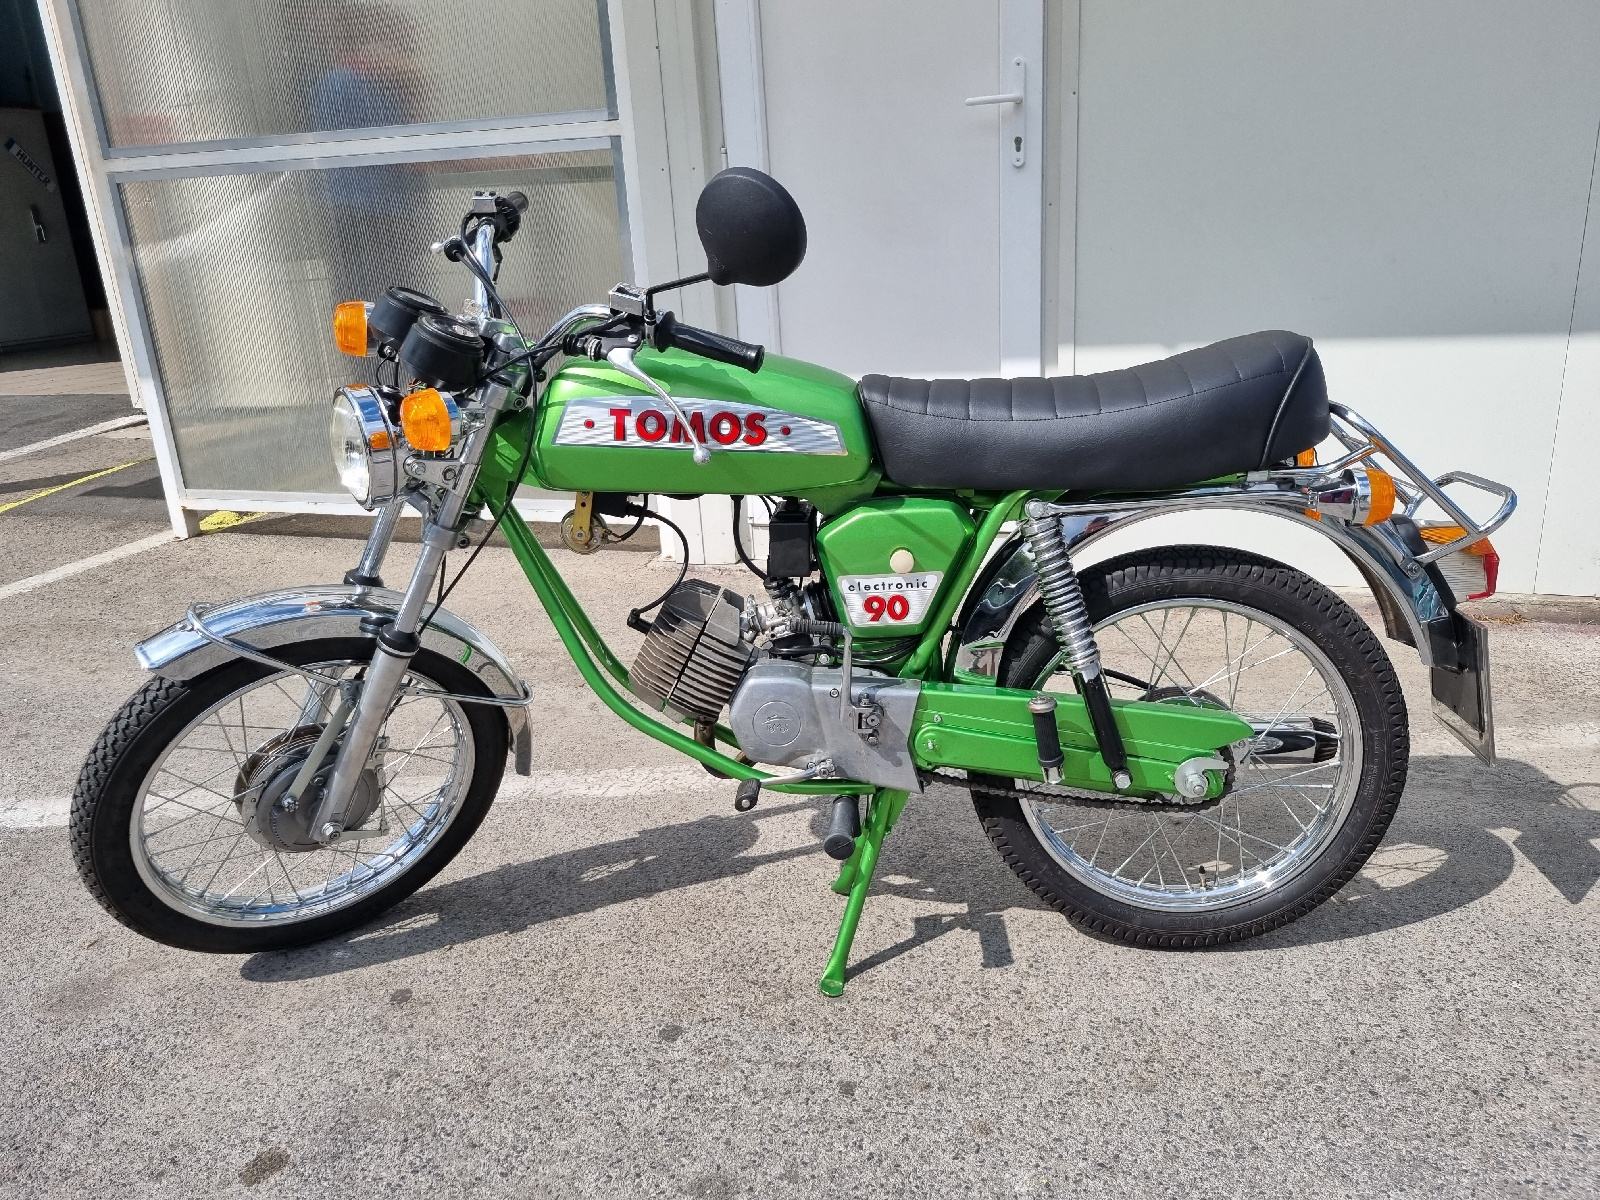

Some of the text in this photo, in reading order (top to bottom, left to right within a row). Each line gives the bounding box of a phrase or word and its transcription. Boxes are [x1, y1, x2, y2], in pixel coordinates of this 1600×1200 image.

[15, 148, 50, 184] HUNTER
[609, 408, 768, 446] TOMOS
[848, 579, 927, 591] electronic
[863, 594, 910, 622] 90
